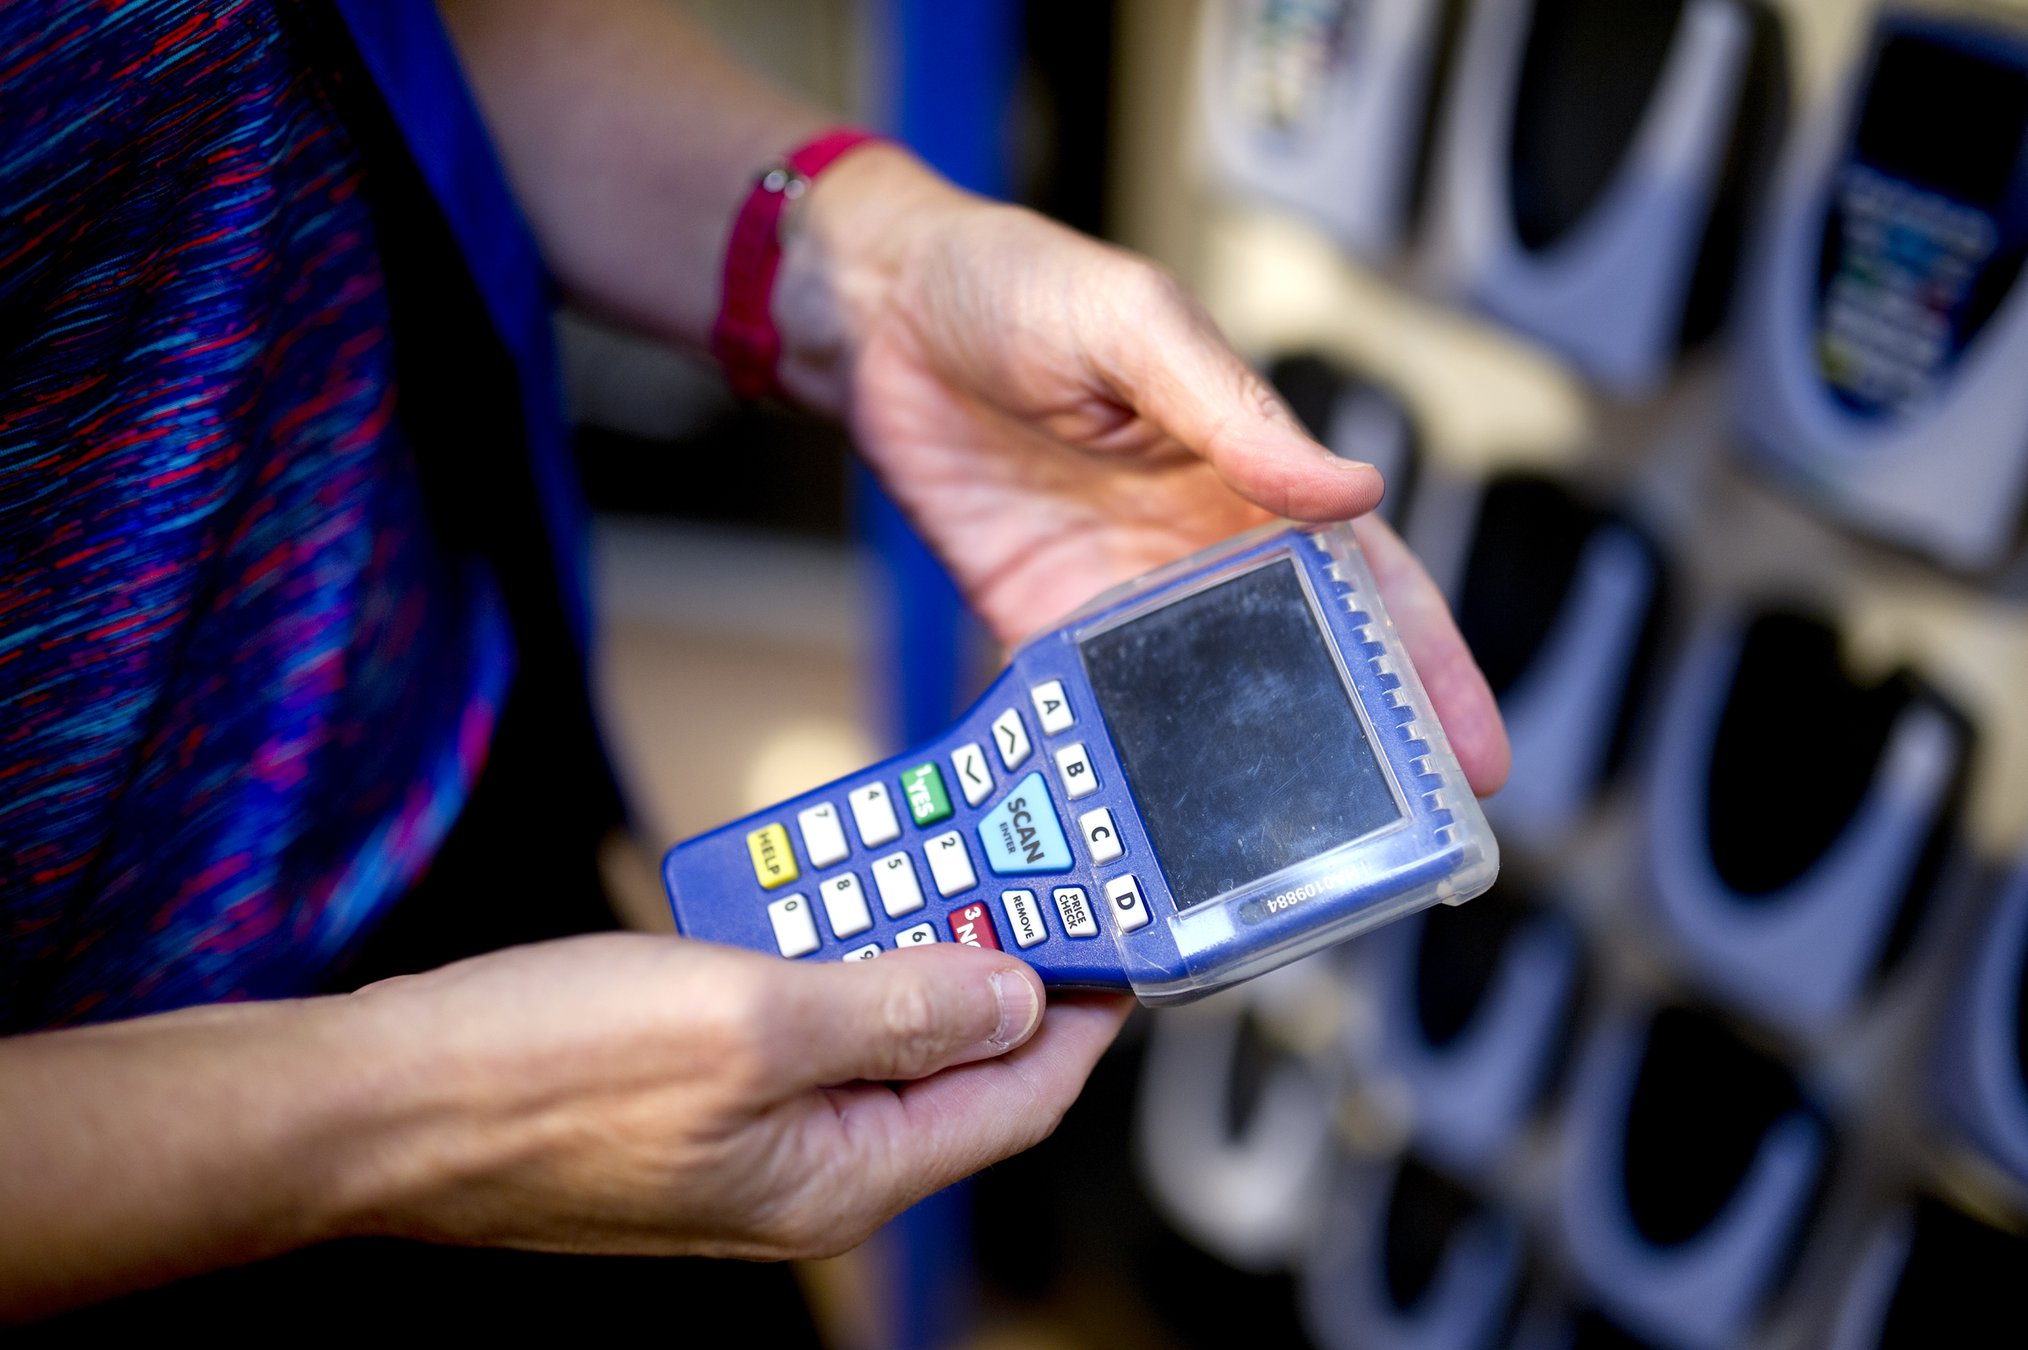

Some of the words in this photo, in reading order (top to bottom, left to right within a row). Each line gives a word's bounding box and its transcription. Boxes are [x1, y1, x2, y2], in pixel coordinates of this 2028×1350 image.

[1043, 699, 1061, 714] A
[1066, 761, 1085, 777] B
[868, 790, 880, 800] 4
[907, 777, 935, 818] YES
[815, 809, 829, 818] 7
[1000, 822, 1017, 854] ENTER
[1008, 797, 1044, 864] SCAN
[1091, 826, 1110, 842] C
[941, 837, 956, 850] 2
[758, 831, 781, 875] HELP
[887, 858, 902, 869] 5
[836, 879, 851, 891] 8
[1069, 893, 1087, 924] PRICE
[1115, 891, 1136, 910] D
[964, 906, 981, 921] 3
[1012, 895, 1035, 939] REMOVE
[1059, 894, 1077, 928] CHECK
[912, 931, 926, 942] 6
